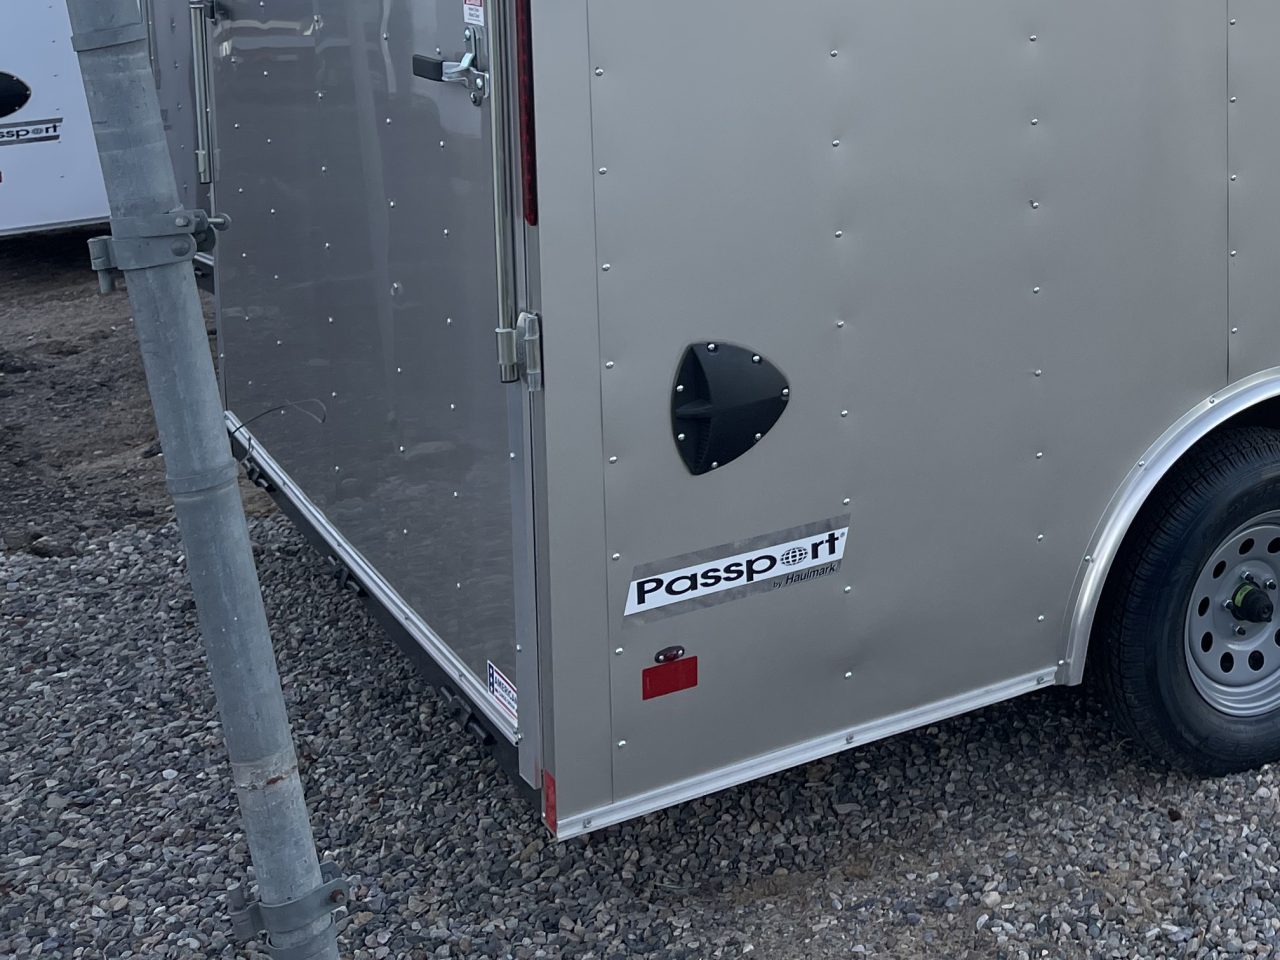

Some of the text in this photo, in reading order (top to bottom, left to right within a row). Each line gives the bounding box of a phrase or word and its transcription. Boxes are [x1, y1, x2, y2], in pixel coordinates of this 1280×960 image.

[636, 532, 839, 605] Passport
[773, 564, 836, 589] by Haulmark
